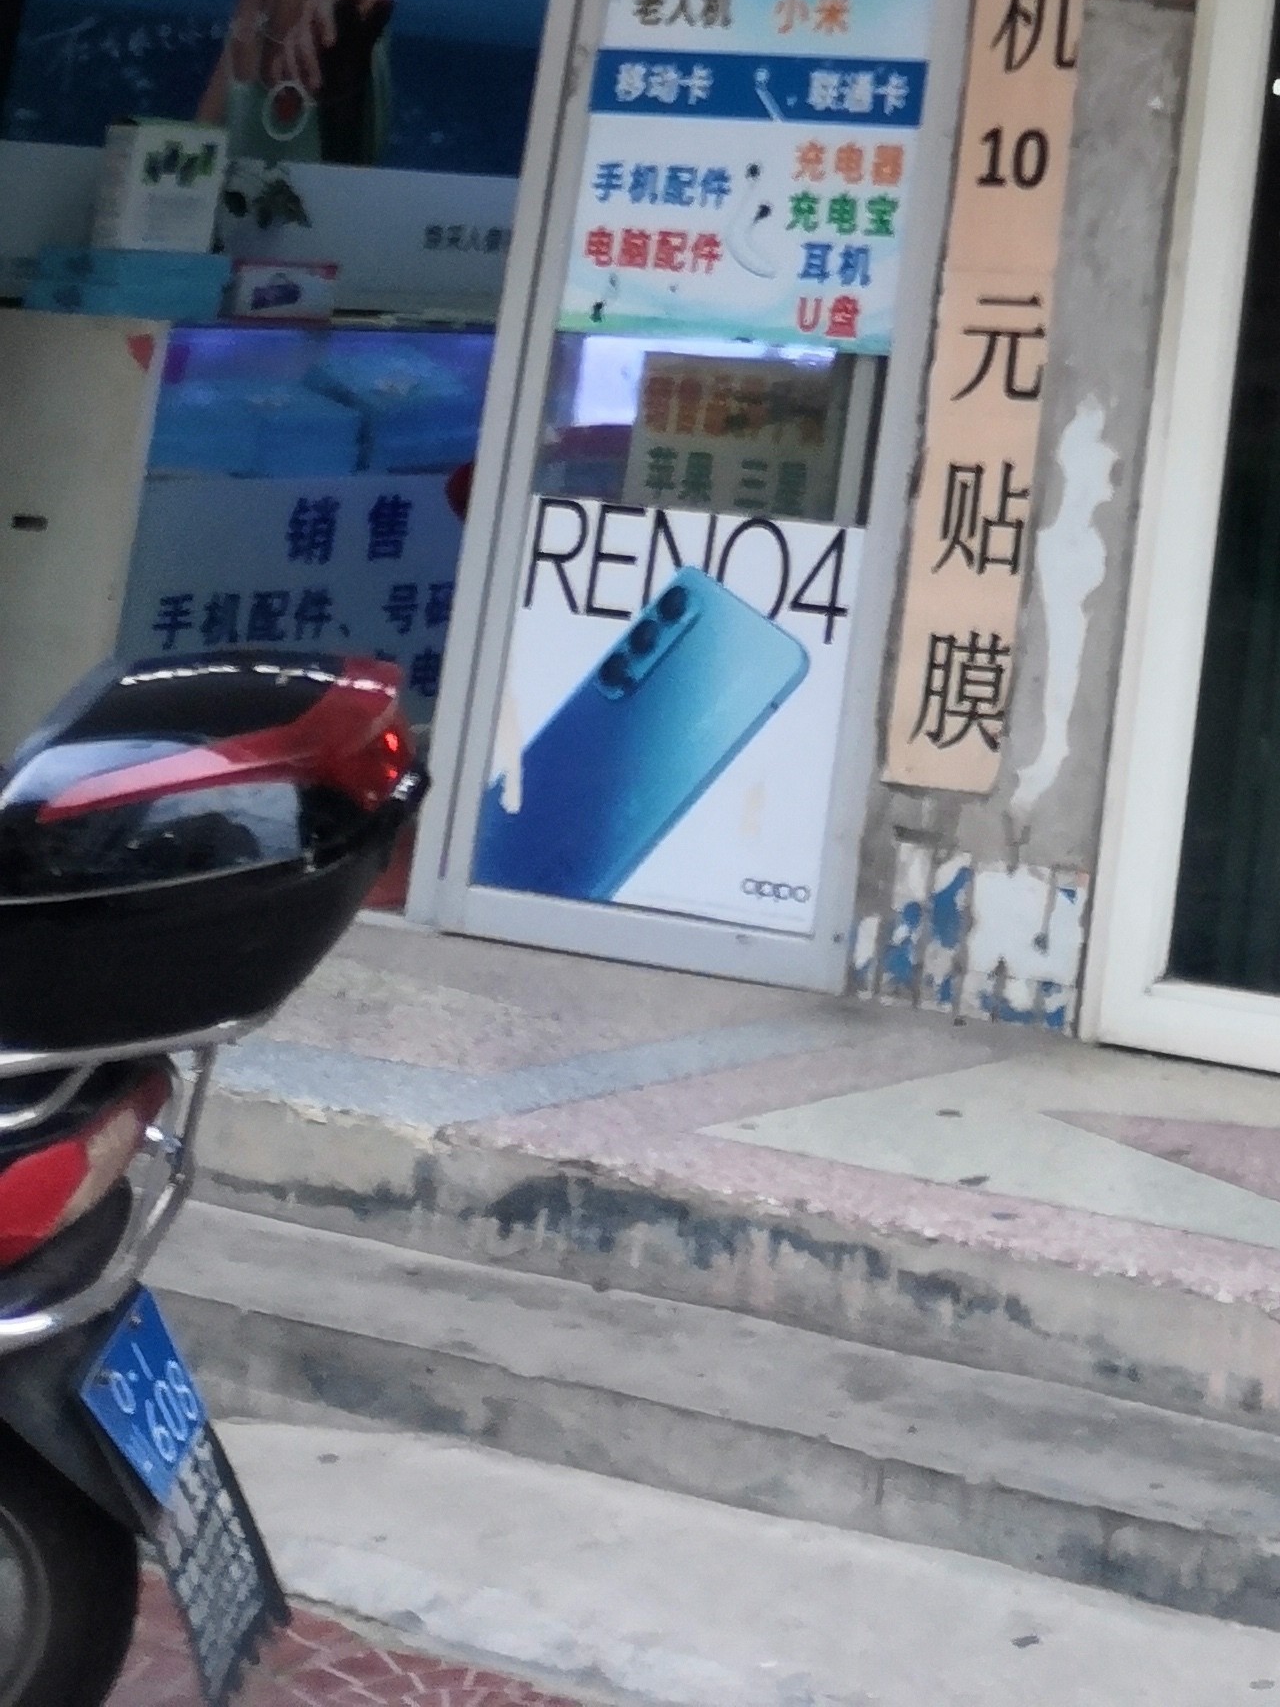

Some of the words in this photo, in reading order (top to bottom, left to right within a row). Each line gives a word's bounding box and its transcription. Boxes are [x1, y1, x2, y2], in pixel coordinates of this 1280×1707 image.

[590, 160, 733, 209] 手机配件
[791, 139, 905, 187] 充电器
[582, 224, 726, 276] 电脑配件
[784, 189, 900, 238] 充电宝
[797, 240, 873, 287] 耳机
[795, 293, 861, 340] U盘
[522, 497, 850, 646] RENO4
